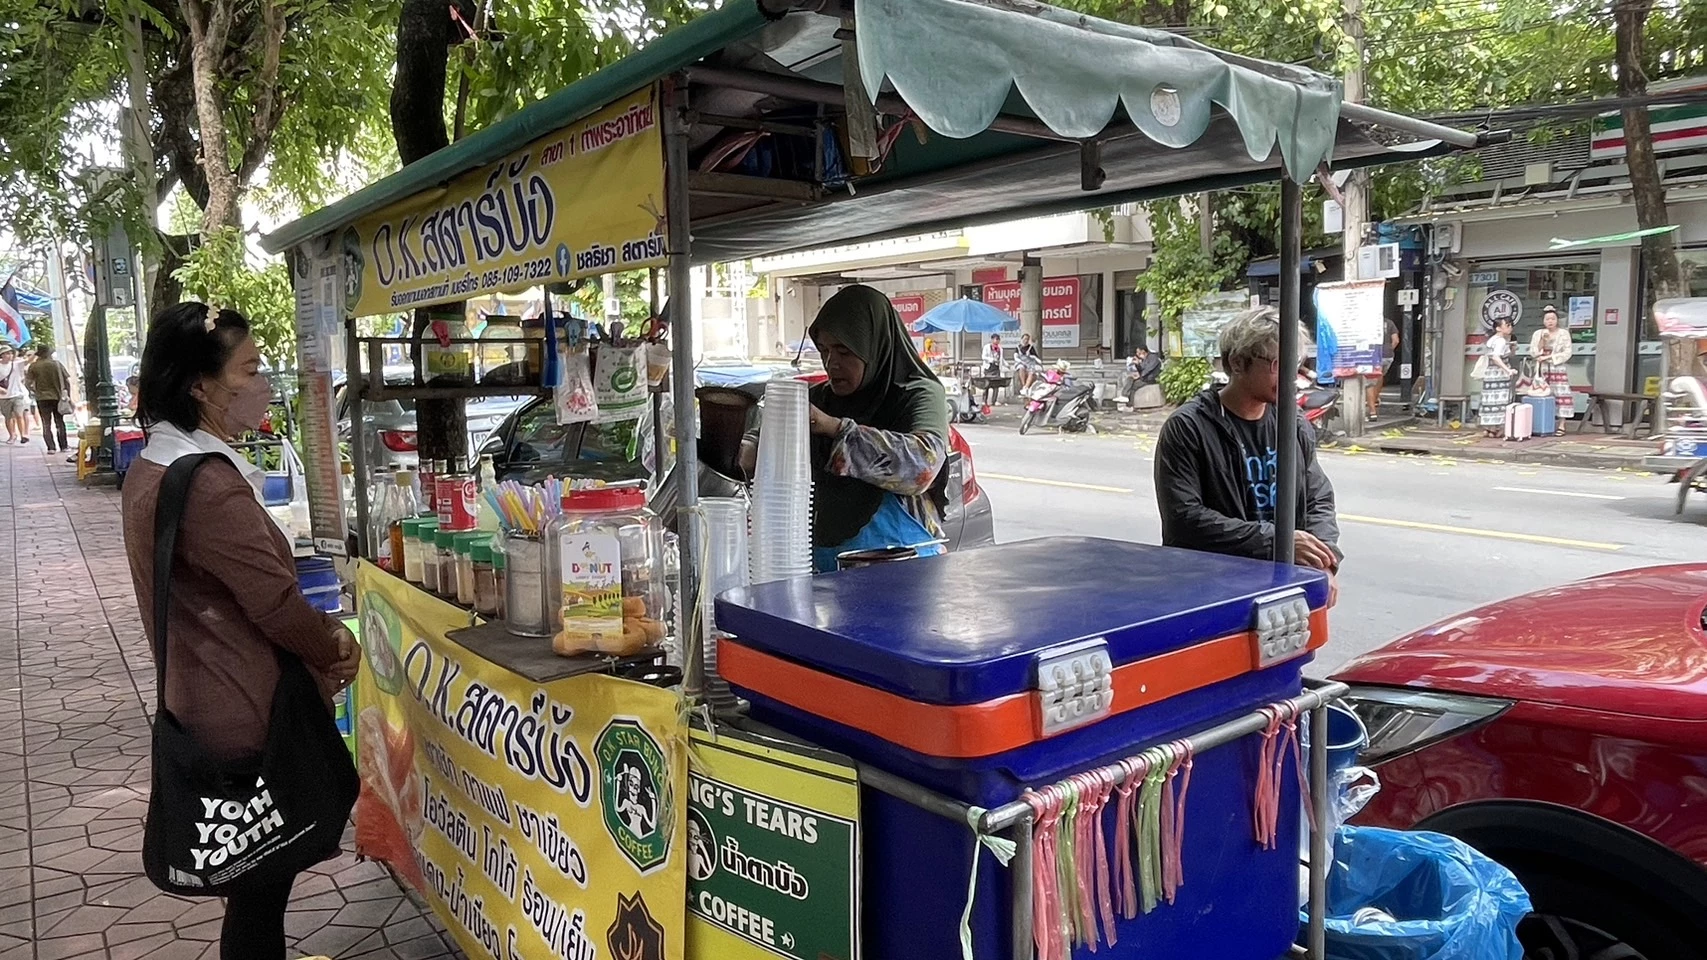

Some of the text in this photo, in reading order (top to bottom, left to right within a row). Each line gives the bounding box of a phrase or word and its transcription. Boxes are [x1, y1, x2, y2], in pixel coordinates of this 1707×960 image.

[541, 105, 654, 166] สาขา 1 ท่าพระอาทิตย
[481, 257, 551, 289] 085-109-7322
[576, 231, 666, 271] ชลธิชา สตาร์บ
[616, 731, 640, 748] STAR
[423, 776, 476, 861] โอวัลติน
[484, 825, 517, 899] โกโก้
[462, 769, 510, 824] กาแฟ
[517, 804, 586, 884] ชาเขียว
[688, 777, 818, 844] NG'S TEARS
[618, 826, 653, 859] COFFEE
[699, 890, 776, 946] COFFEE
